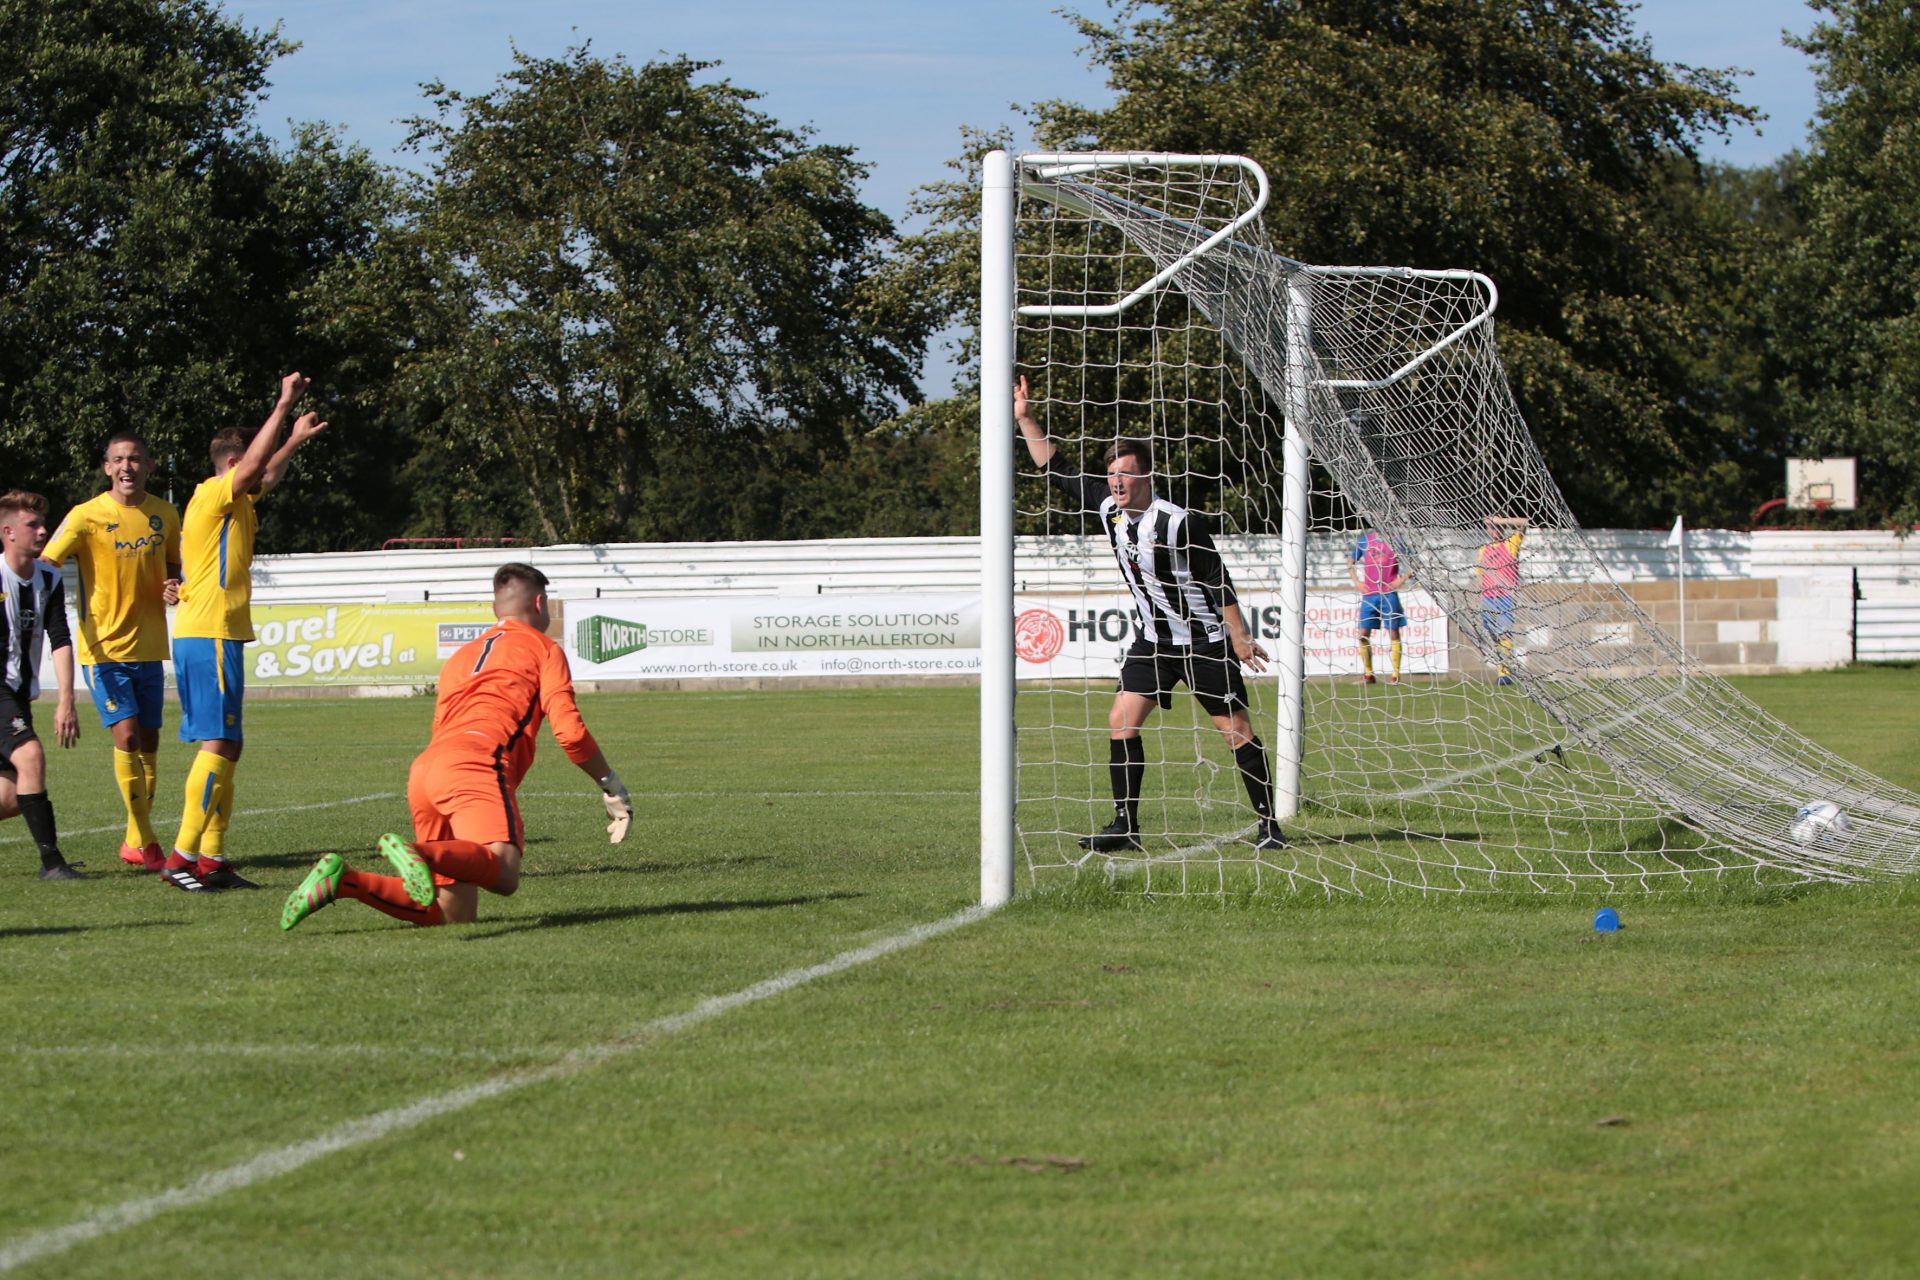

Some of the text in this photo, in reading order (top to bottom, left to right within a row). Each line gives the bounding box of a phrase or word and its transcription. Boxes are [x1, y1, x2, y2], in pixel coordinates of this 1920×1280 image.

[754, 613, 960, 629] STORAGE SOLUTIONS
[600, 622, 708, 652] NORTH STORE
[758, 632, 955, 648] IN NORTHALLERTON
[255, 632, 415, 678] & Save! at
[473, 631, 504, 676] 1
[641, 660, 798, 674] www.north-store.co.uk
[821, 657, 981, 672] info@north-store.co.uk
